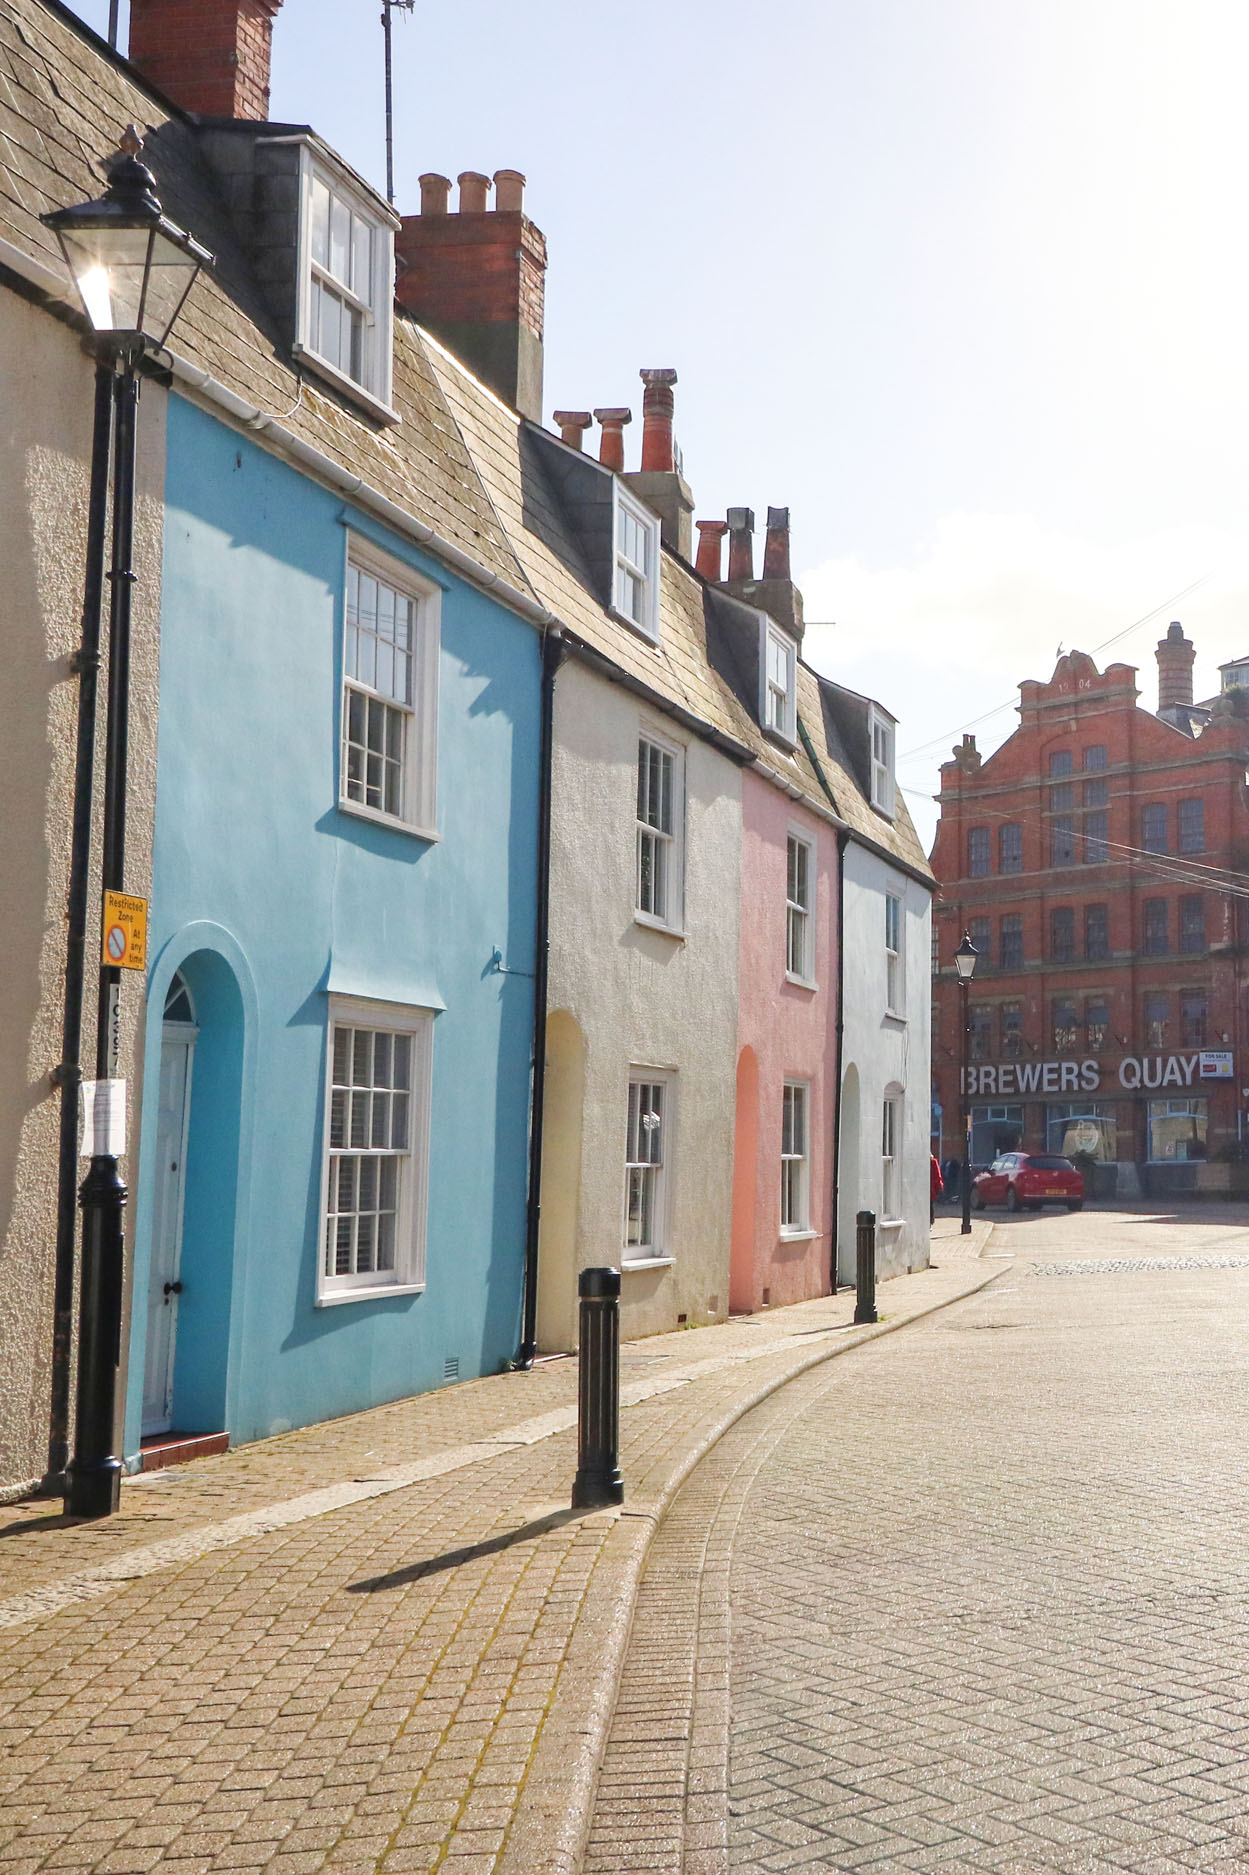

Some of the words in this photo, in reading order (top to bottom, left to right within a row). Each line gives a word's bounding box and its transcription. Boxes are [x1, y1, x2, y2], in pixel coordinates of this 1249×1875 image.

[109, 894, 143, 912] Restricted
[118, 910, 134, 923] Zone
[133, 928, 141, 940] At
[130, 942, 142, 954] any
[129, 953, 144, 965] time
[960, 1060, 1100, 1095] BREWERS
[1118, 1055, 1199, 1090] QUAY
